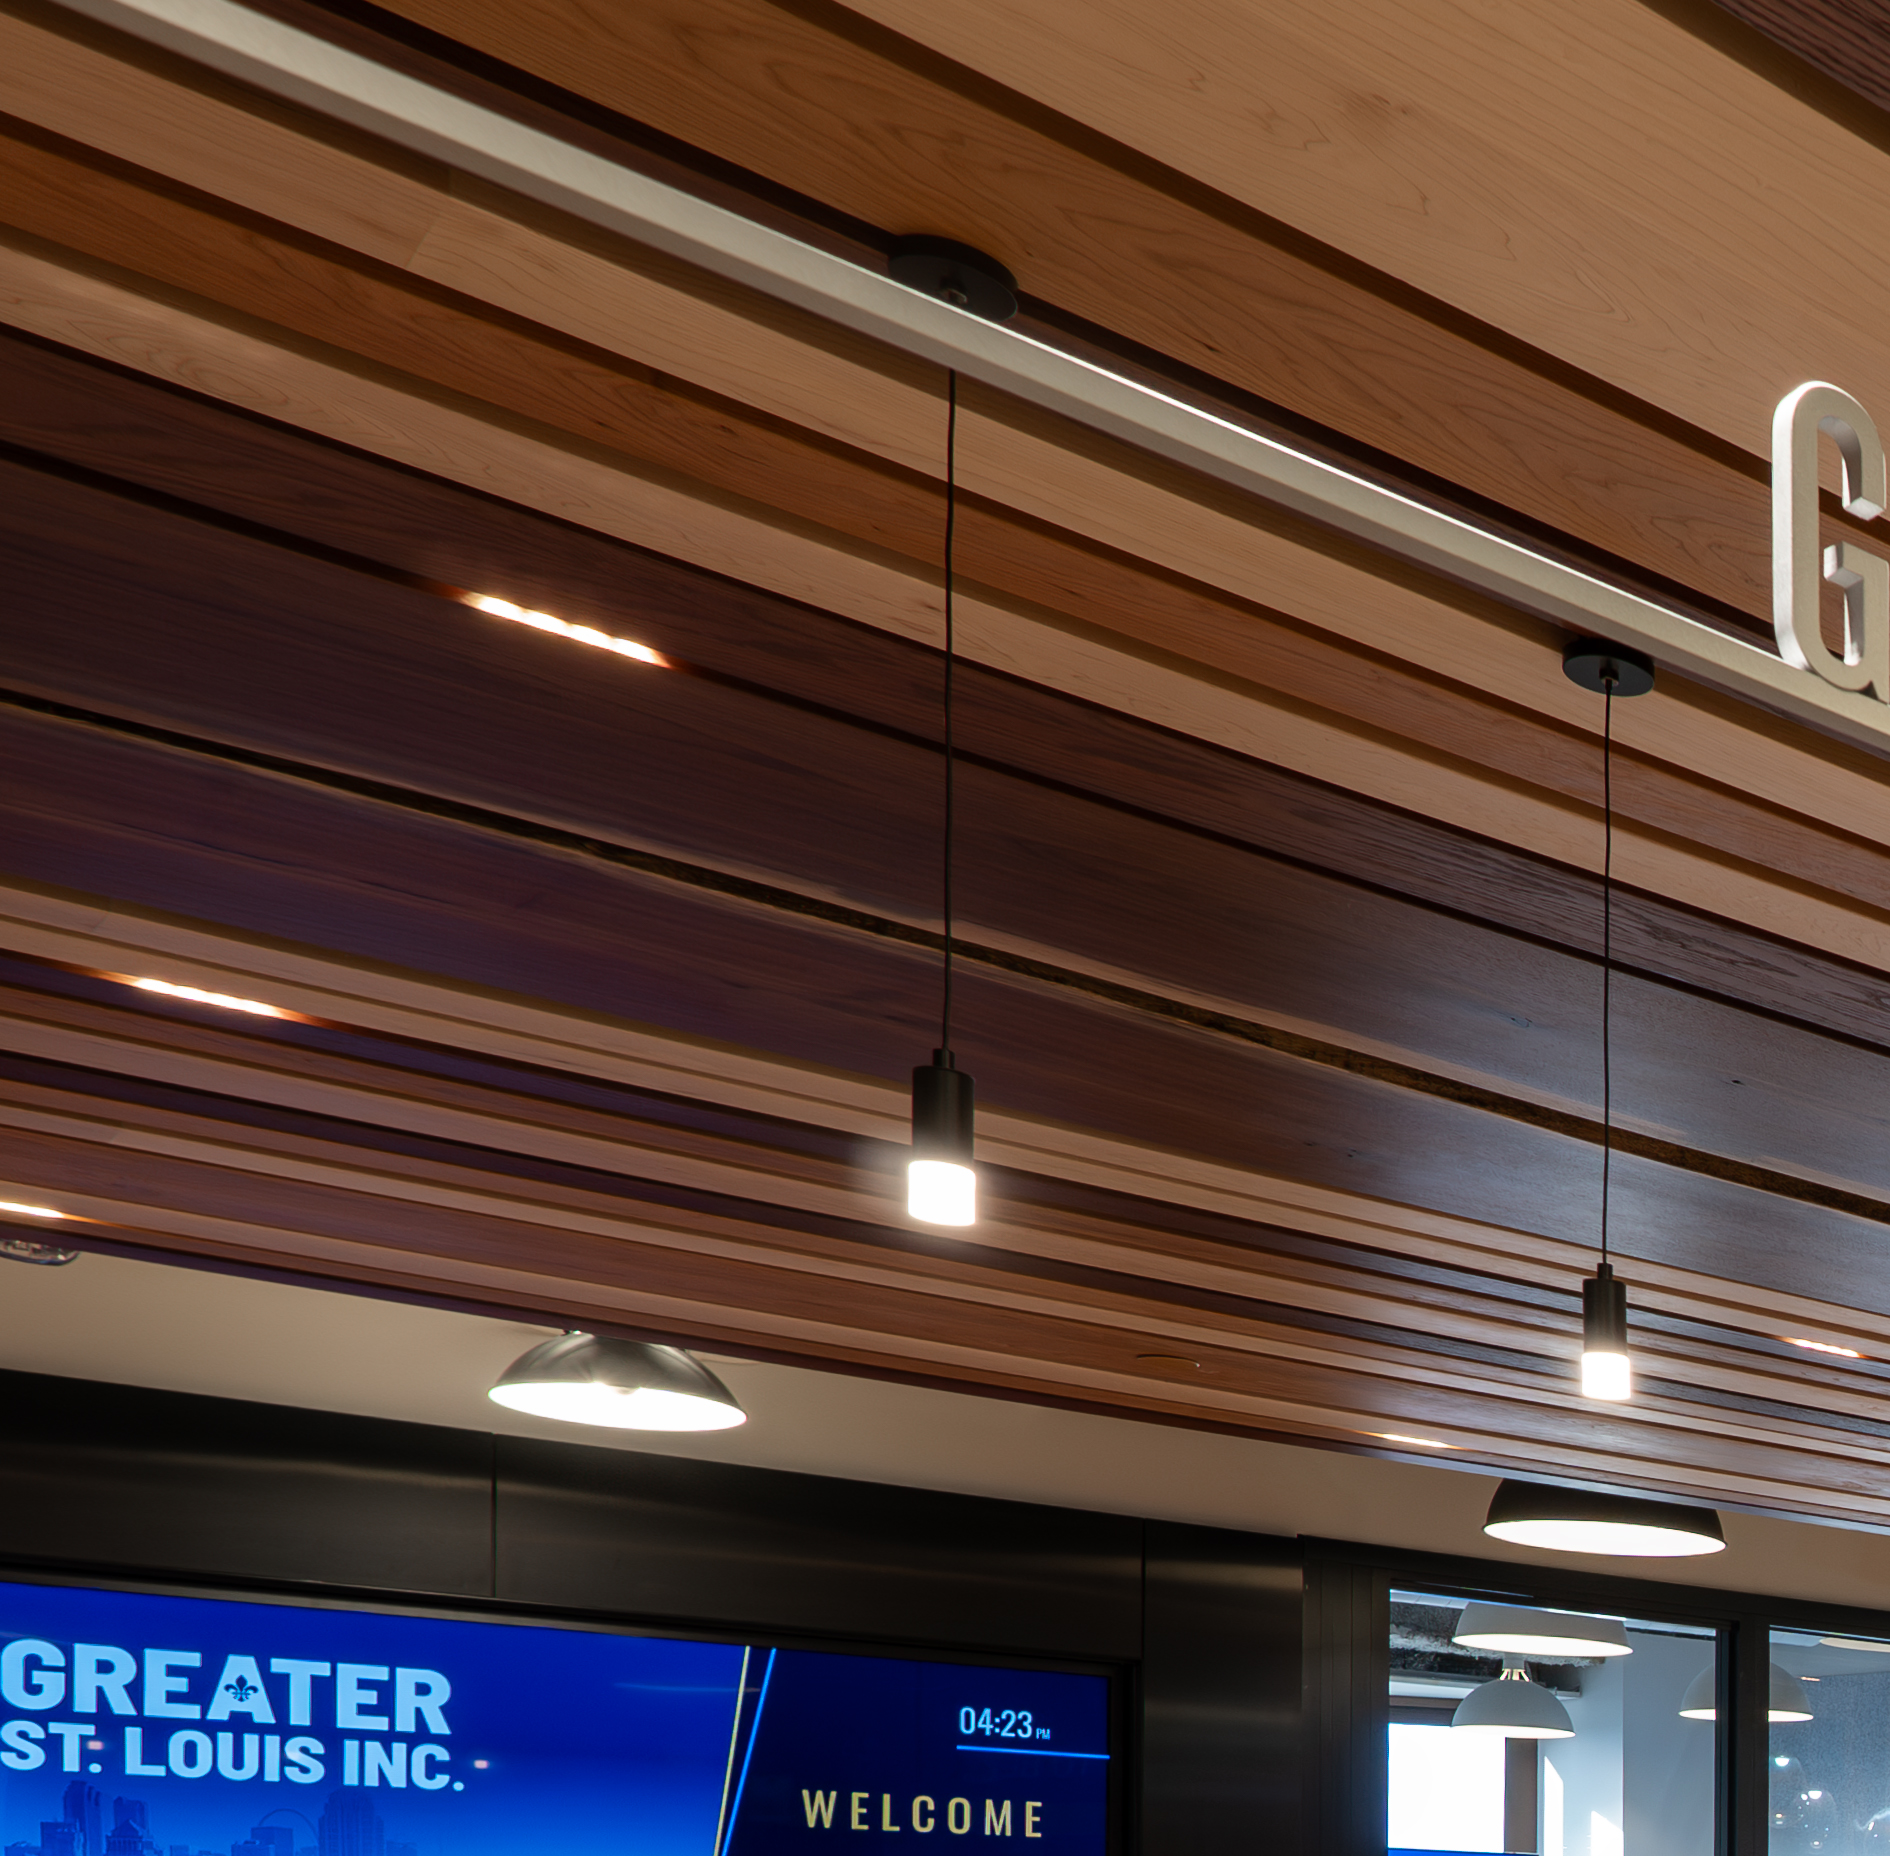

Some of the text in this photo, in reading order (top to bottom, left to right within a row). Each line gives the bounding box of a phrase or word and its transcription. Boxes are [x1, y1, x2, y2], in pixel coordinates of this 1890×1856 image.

[0, 1638, 452, 1735] GREATER
[958, 1706, 1051, 1740] 04:23 PM
[0, 1720, 466, 1792] ST. LOUIS INC.
[801, 1788, 1043, 1838] WELCOME
